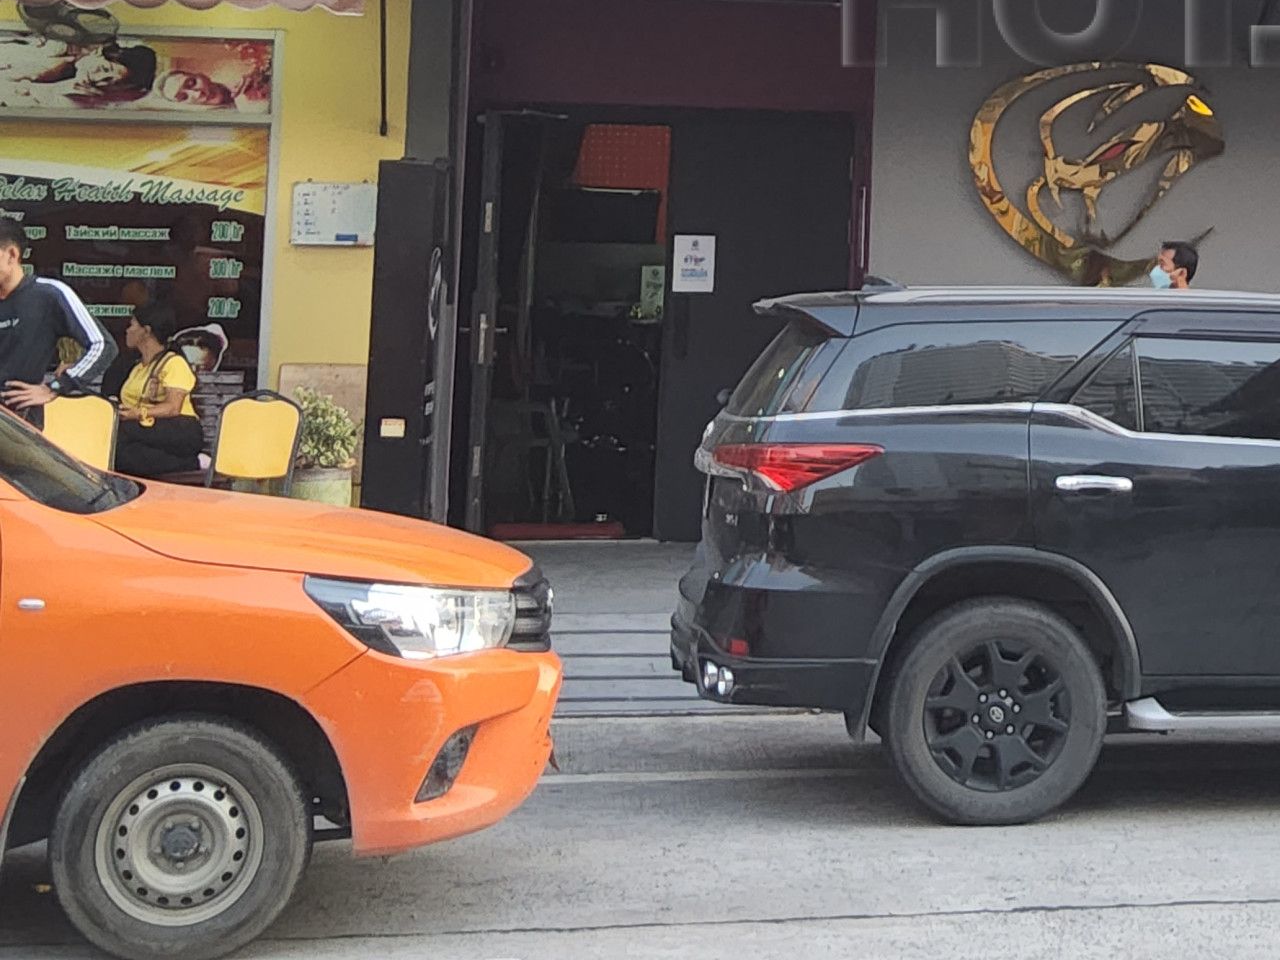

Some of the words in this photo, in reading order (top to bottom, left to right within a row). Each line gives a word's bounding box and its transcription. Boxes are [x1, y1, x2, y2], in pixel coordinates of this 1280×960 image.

[52, 177, 134, 202] Health
[141, 179, 245, 211] Massage
[65, 226, 118, 240] Тайский
[119, 227, 170, 241] массаж
[63, 262, 113, 277] Массаж
[124, 265, 176, 278] маслом
